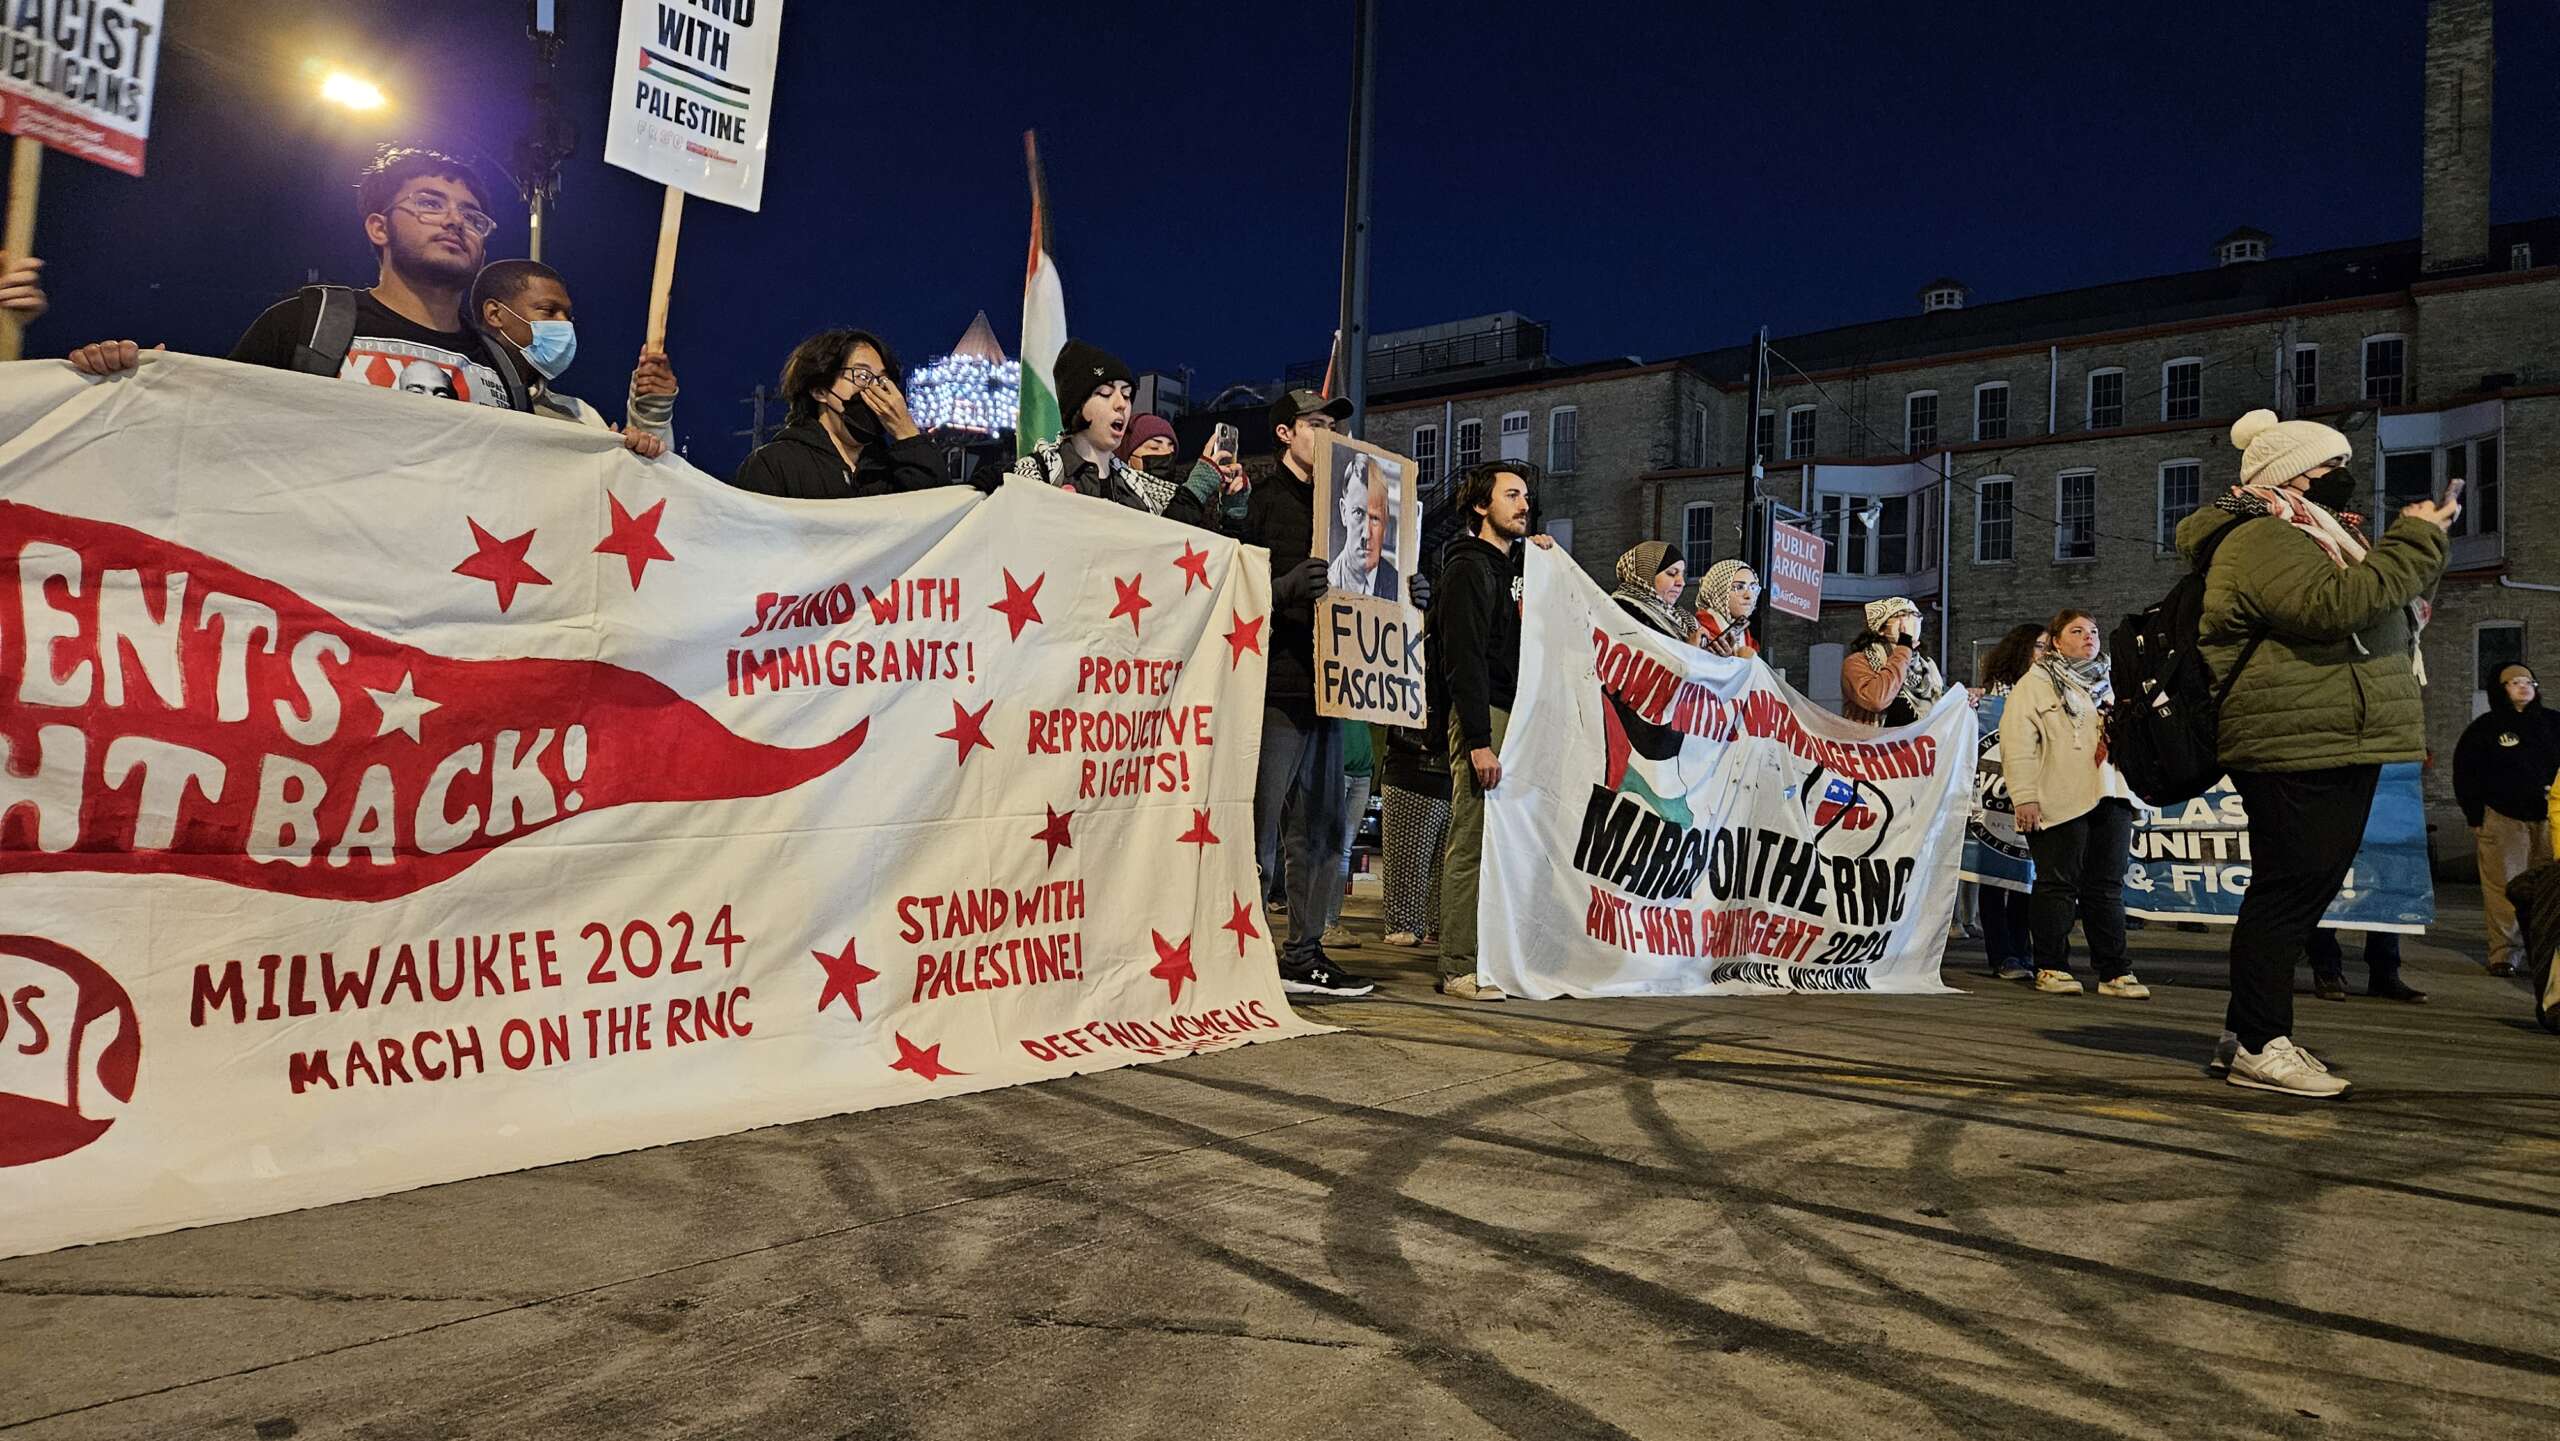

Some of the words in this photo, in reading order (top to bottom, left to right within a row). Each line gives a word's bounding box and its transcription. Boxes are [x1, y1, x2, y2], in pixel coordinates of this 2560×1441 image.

[0, 0, 152, 78] ACIST
[658, 3, 730, 71] WITH
[635, 80, 746, 144] PALESTINE
[1773, 555, 1820, 586] ARKING
[1774, 531, 1817, 562] PUBLIC
[740, 582, 856, 637] STAND
[862, 578, 960, 626] WITH
[1331, 604, 1424, 675] FUCK
[0, 540, 350, 745] ENTS
[726, 639, 975, 697] IMMIGRANTS!
[1077, 656, 1183, 697] PROTECT
[1323, 660, 1422, 720] FASCISTS
[1593, 626, 1682, 725] DOWN
[1671, 681, 1727, 742] WITH
[1027, 705, 1213, 755] REPRODUCTIVE
[247, 724, 588, 868] BACK!
[1079, 751, 1190, 799] RIGHTS!
[1573, 784, 1710, 901] MARCH
[1709, 826, 1752, 901] ON
[1749, 829, 1828, 918] THE
[1833, 856, 1915, 927] RNC
[2123, 863, 2155, 893] &
[897, 886, 1009, 944] STAND
[1014, 878, 1085, 927] WITH
[1586, 885, 1696, 957] ANTI-WAR
[1813, 930, 1893, 964] 2024
[191, 929, 563, 1028] MILWAUKEE
[578, 904, 746, 985] 2024
[912, 932, 1084, 1004] PALESTINE!
[1788, 966, 1871, 990] WISCONSIN
[289, 1024, 485, 1095] MARCH
[500, 1013, 571, 1072] ON
[584, 1002, 652, 1061] THE
[666, 986, 754, 1048] RNC
[1150, 1000, 1280, 1042] WOMEN'S
